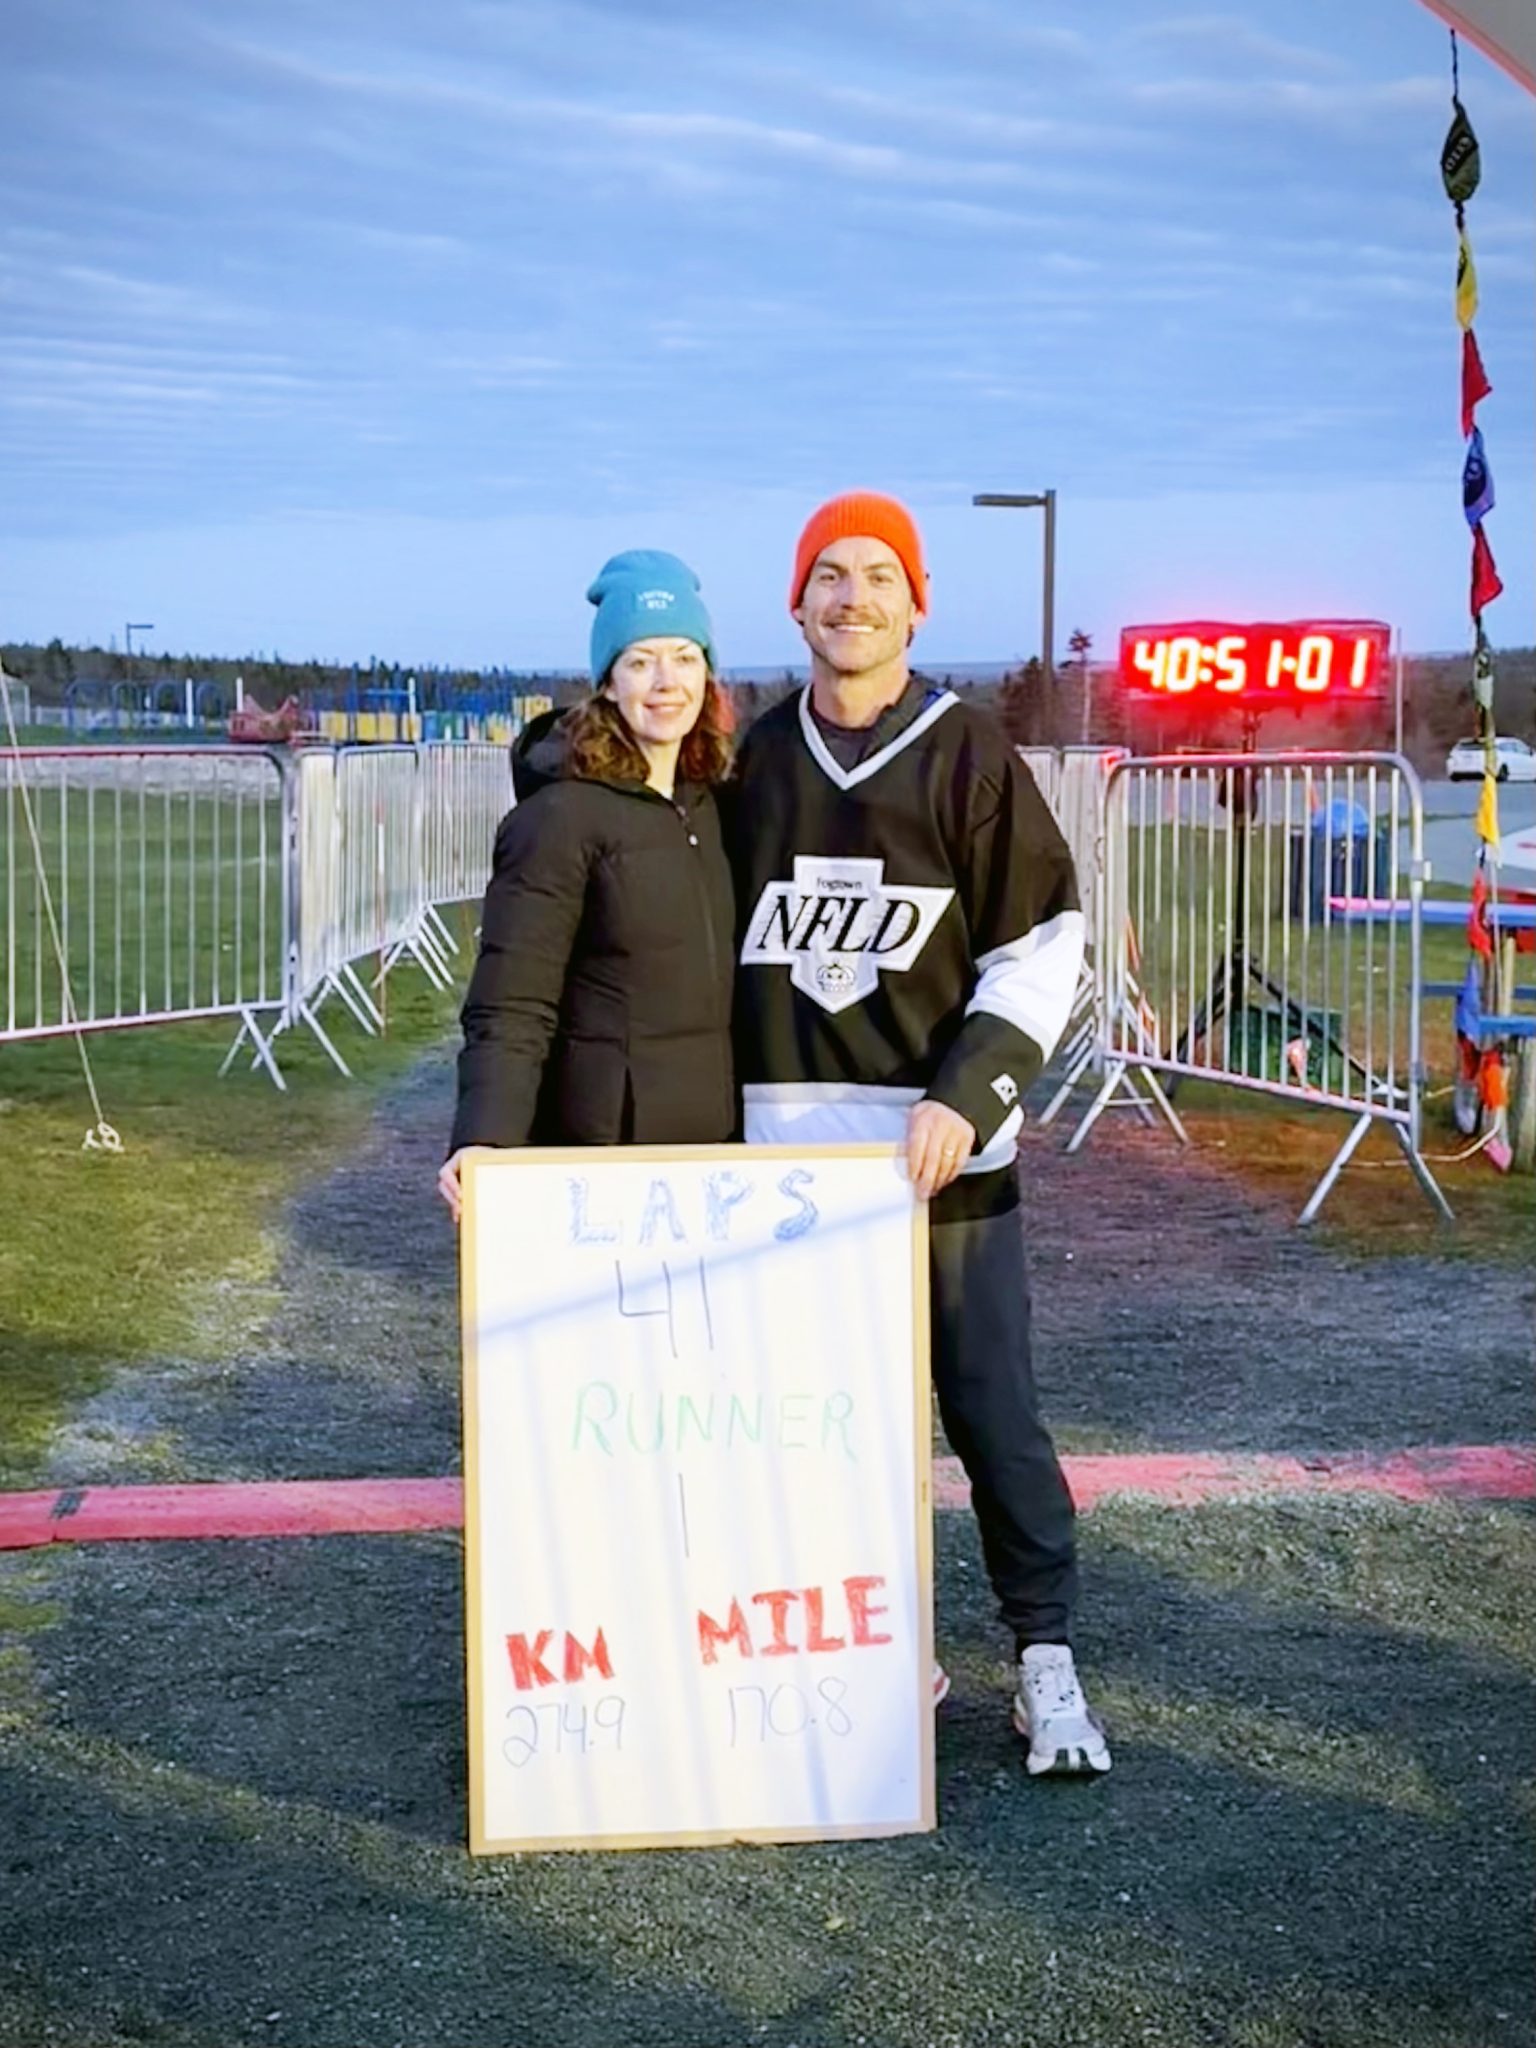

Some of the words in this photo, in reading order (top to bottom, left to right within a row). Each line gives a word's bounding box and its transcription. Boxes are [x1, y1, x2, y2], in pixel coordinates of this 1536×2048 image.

[756, 894, 922, 954] NFLD
[568, 1169, 819, 1246] LAPS
[615, 1255, 714, 1358] 41
[571, 1380, 858, 1462] RUNNER
[505, 1626, 615, 1691] KM
[697, 1575, 893, 1666] MILE
[502, 1695, 626, 1767] 274.9
[727, 1677, 852, 1748] 170.8
